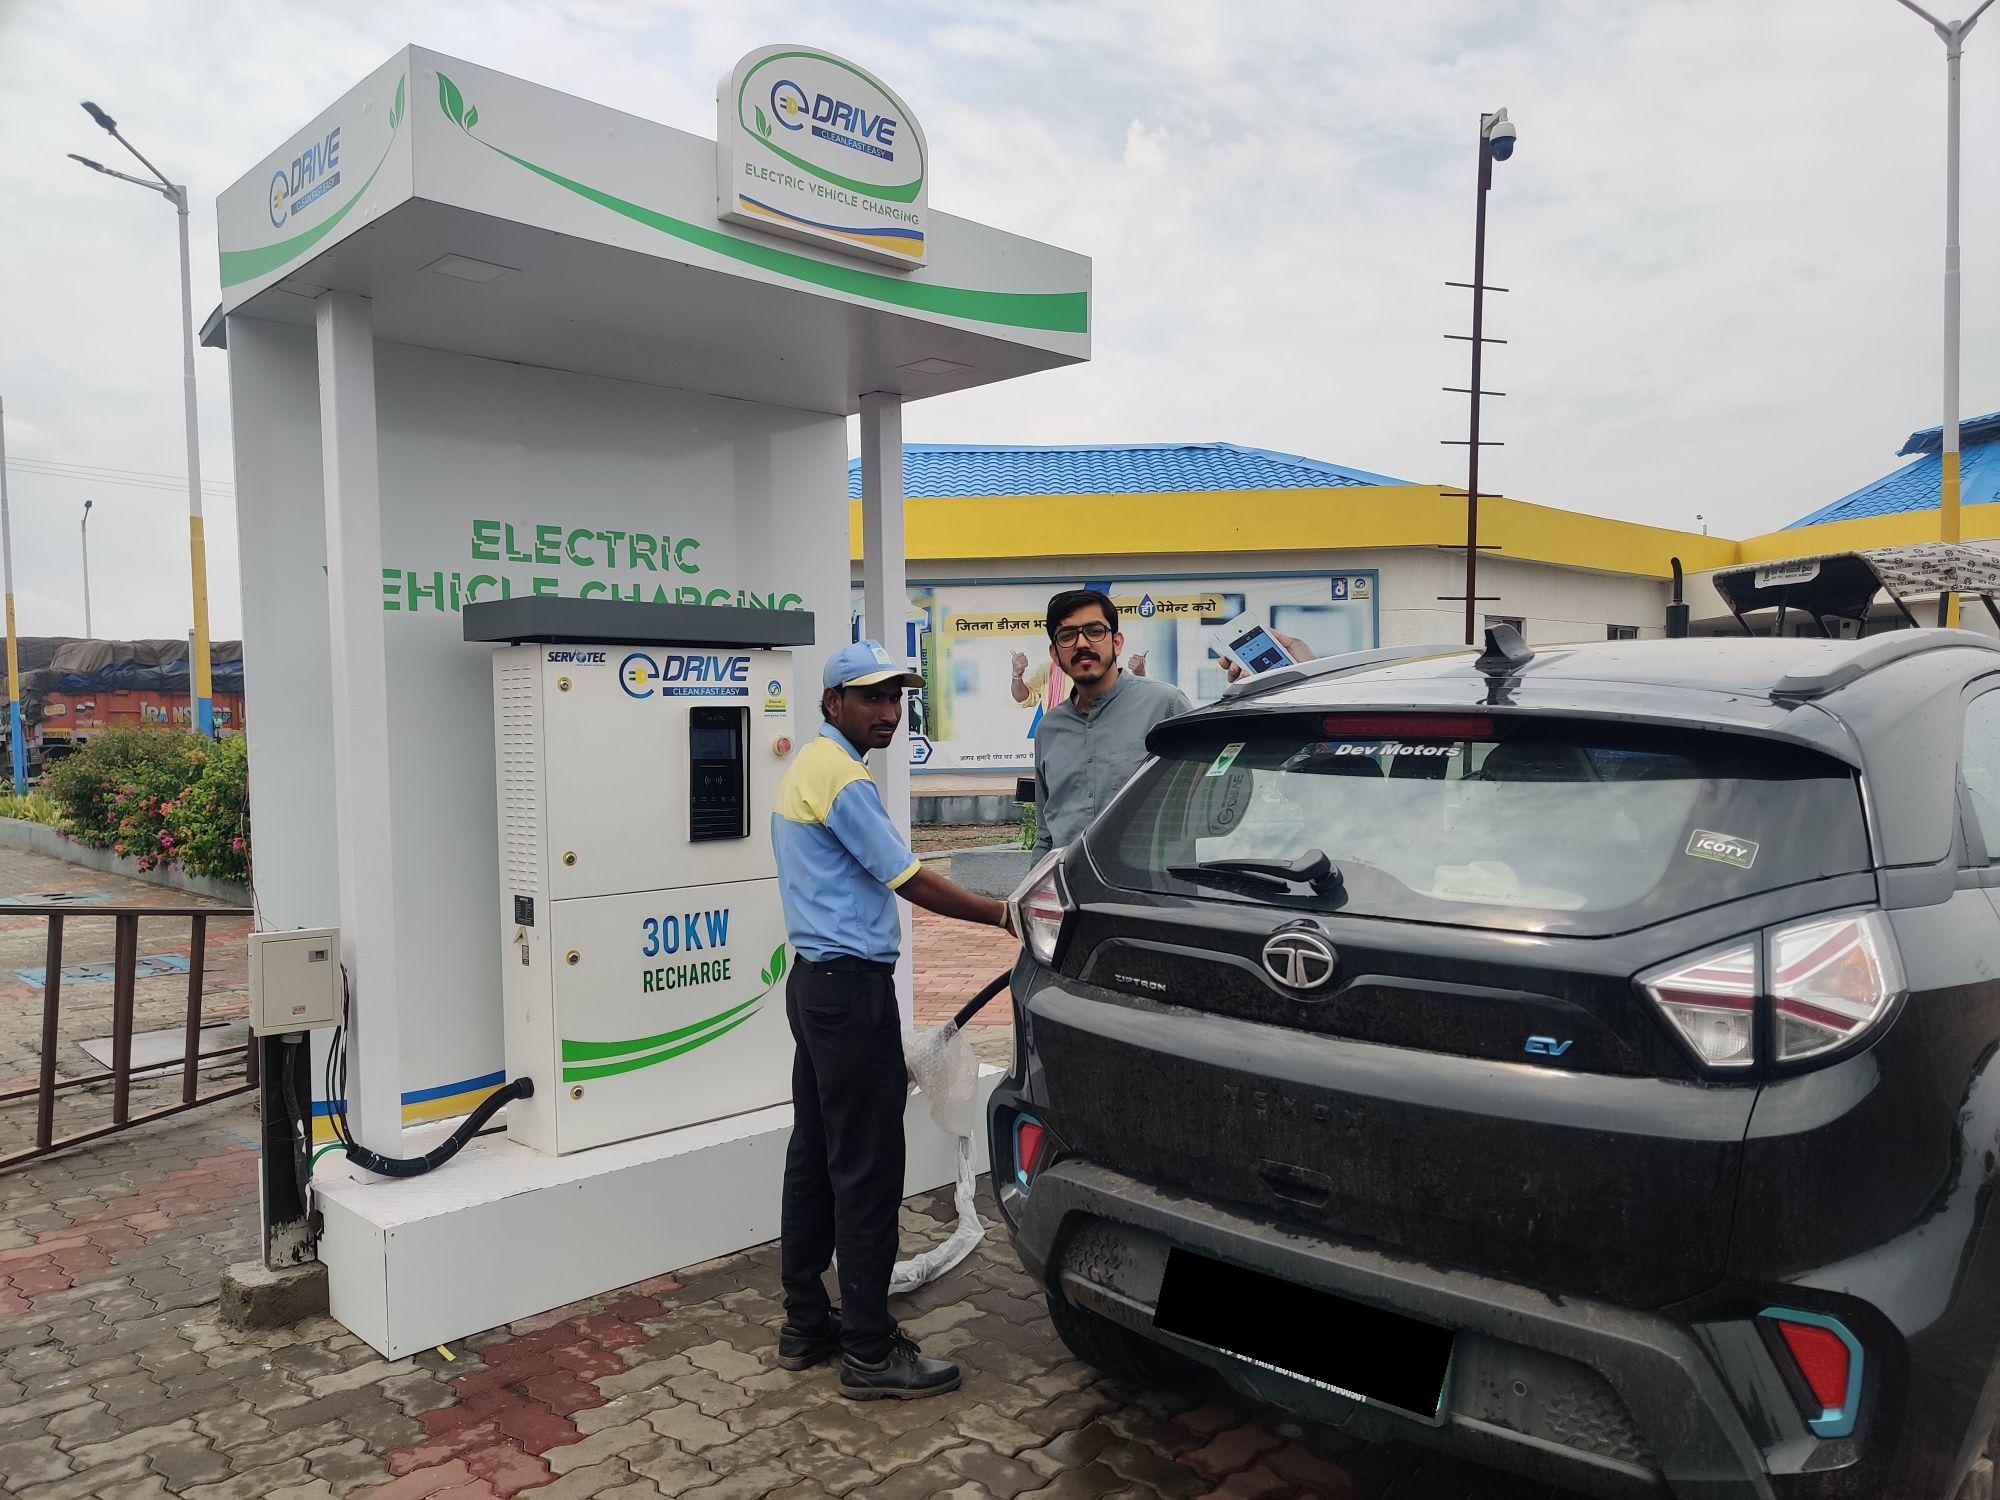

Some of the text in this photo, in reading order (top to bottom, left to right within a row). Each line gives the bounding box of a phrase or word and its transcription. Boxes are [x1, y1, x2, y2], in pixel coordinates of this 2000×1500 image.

[811, 93, 897, 146] DRIVE
[291, 126, 340, 197] DRIVE
[745, 162, 919, 225] ELECTRIC VEHICLE CHARGING
[472, 519, 701, 574] ELECTRIC
[382, 568, 559, 612] EHICLE
[955, 618, 994, 631] जितना
[996, 617, 1030, 632] डीज़ल
[1115, 604, 1138, 615] तना
[1140, 601, 1153, 615] ही
[1156, 600, 1188, 613] पेमेन्ट
[1192, 598, 1217, 612] करो
[662, 655, 751, 682] DRIVE
[1334, 743, 1461, 757] Dev Motors
[1697, 839, 1748, 857] ICOTY
[643, 958, 732, 993] RECHARGE
[1114, 974, 1167, 992] ZIPTRON
[1524, 1036, 1574, 1057] EV
